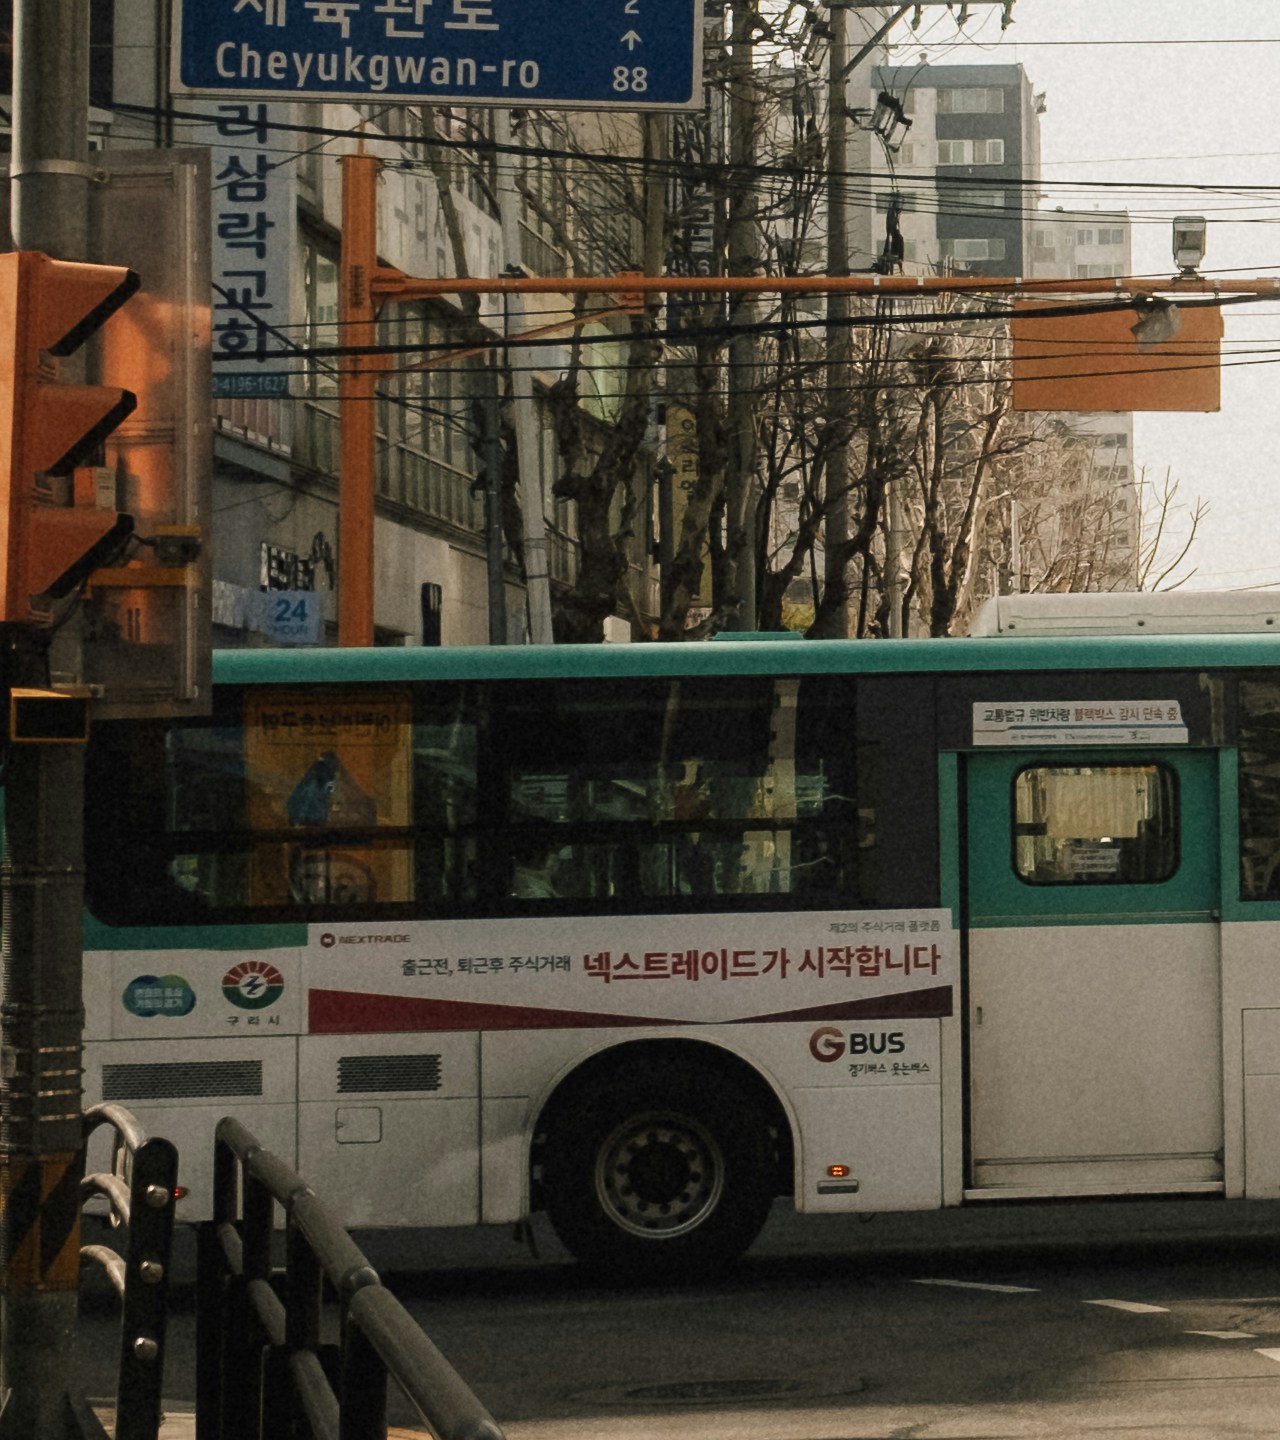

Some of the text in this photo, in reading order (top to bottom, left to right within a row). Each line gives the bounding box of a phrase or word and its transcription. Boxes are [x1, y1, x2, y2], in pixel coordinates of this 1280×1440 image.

[214, 39, 540, 91] Cheyukgwan-ro
[611, 66, 649, 94] 88
[273, 599, 308, 622] 24
[984, 707, 1025, 722] 교통법규
[1029, 706, 1071, 722] 위반차량
[1074, 706, 1117, 722] 블랙박스
[1143, 706, 1164, 722] 단속
[1166, 706, 1179, 722] 중
[402, 942, 942, 984] 출근전, 퇴근후 주식거래 넥스트레이드가 시작합니다
[227, 1015, 281, 1027] 구리시
